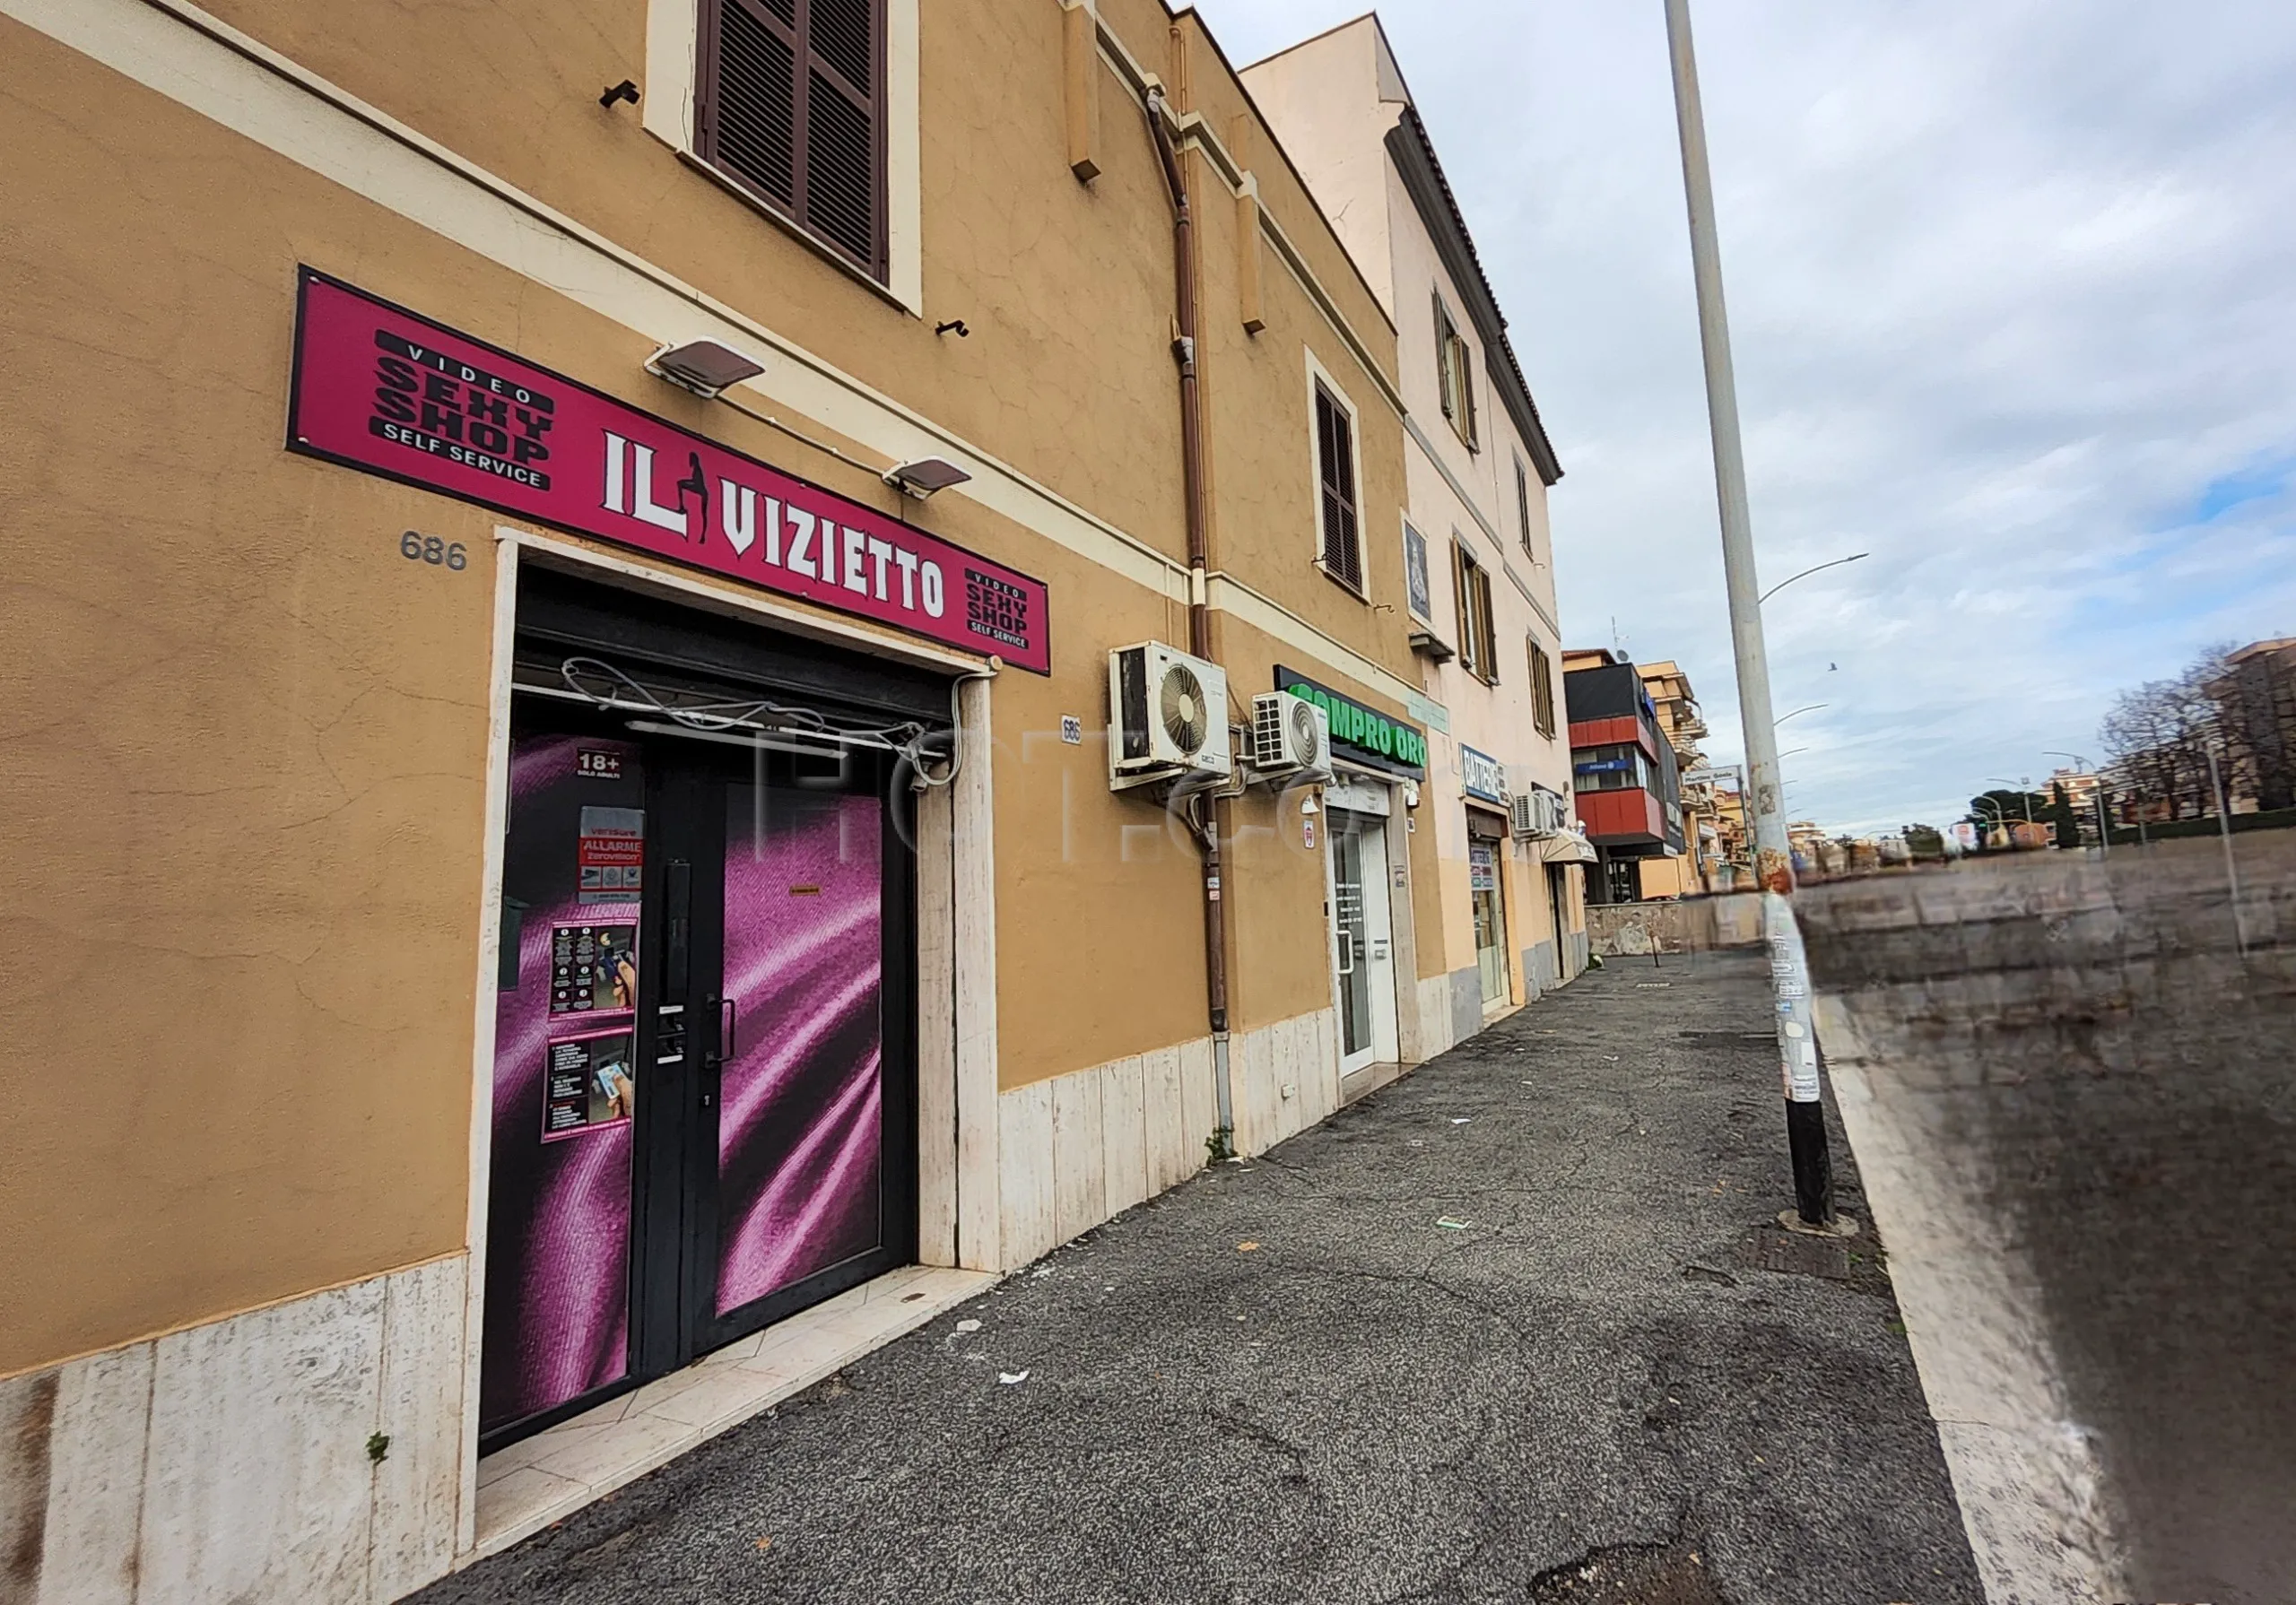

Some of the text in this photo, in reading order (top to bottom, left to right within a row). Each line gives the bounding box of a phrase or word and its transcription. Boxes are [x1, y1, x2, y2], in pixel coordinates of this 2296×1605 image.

[408, 345, 531, 403] VIDEO
[373, 357, 554, 438] SEXY
[372, 387, 550, 465] SHOP
[384, 423, 541, 488] SELF SERVICE
[602, 430, 944, 620] IL VIZIETTO
[400, 530, 467, 571] 686
[966, 583, 1027, 618] SEXY
[974, 574, 1019, 598] VIDEO
[967, 601, 1027, 635] SHOP
[971, 621, 1025, 647] SELF SERVICE
[579, 753, 619, 771] 18+
[1396, 725, 1428, 768] ORO
[584, 839, 642, 852] ALLARME
